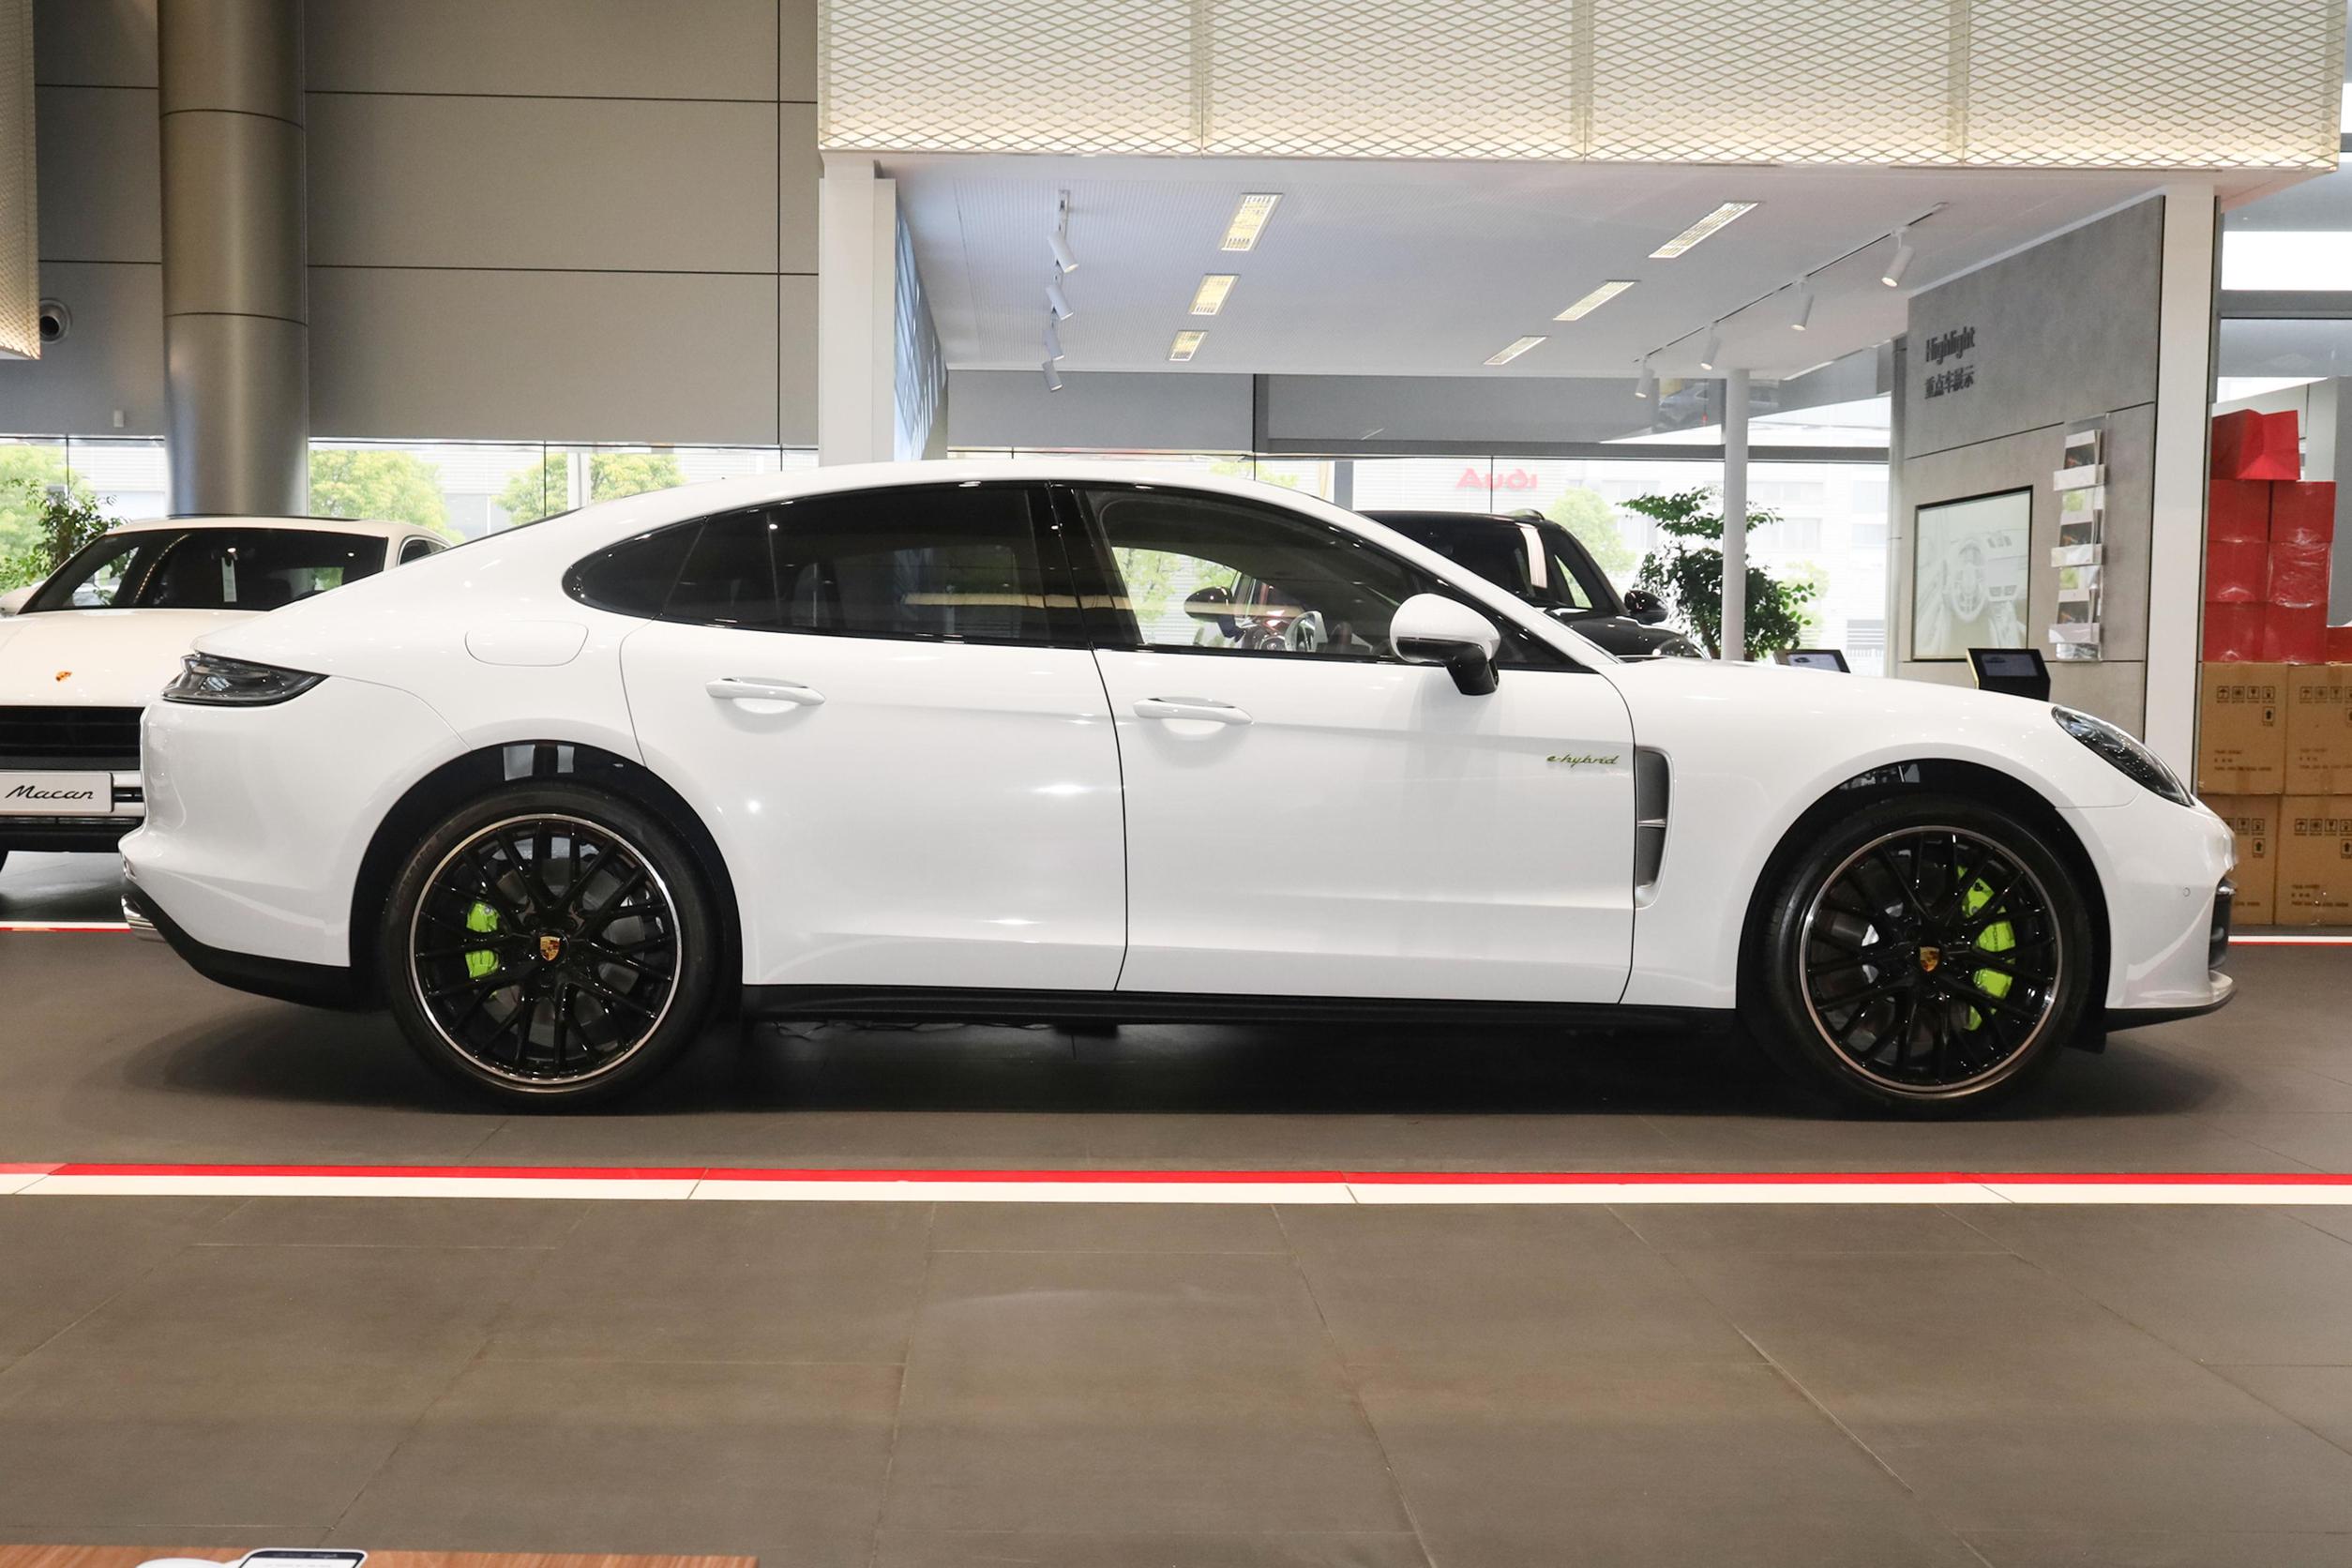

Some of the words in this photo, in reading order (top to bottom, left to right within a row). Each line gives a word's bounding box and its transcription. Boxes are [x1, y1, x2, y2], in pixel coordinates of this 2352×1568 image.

[1926, 326, 1975, 365] Highlight
[1924, 365, 1974, 400] 重点车展示
[1455, 468, 1537, 489] Audi
[5, 785, 94, 799] Macan
